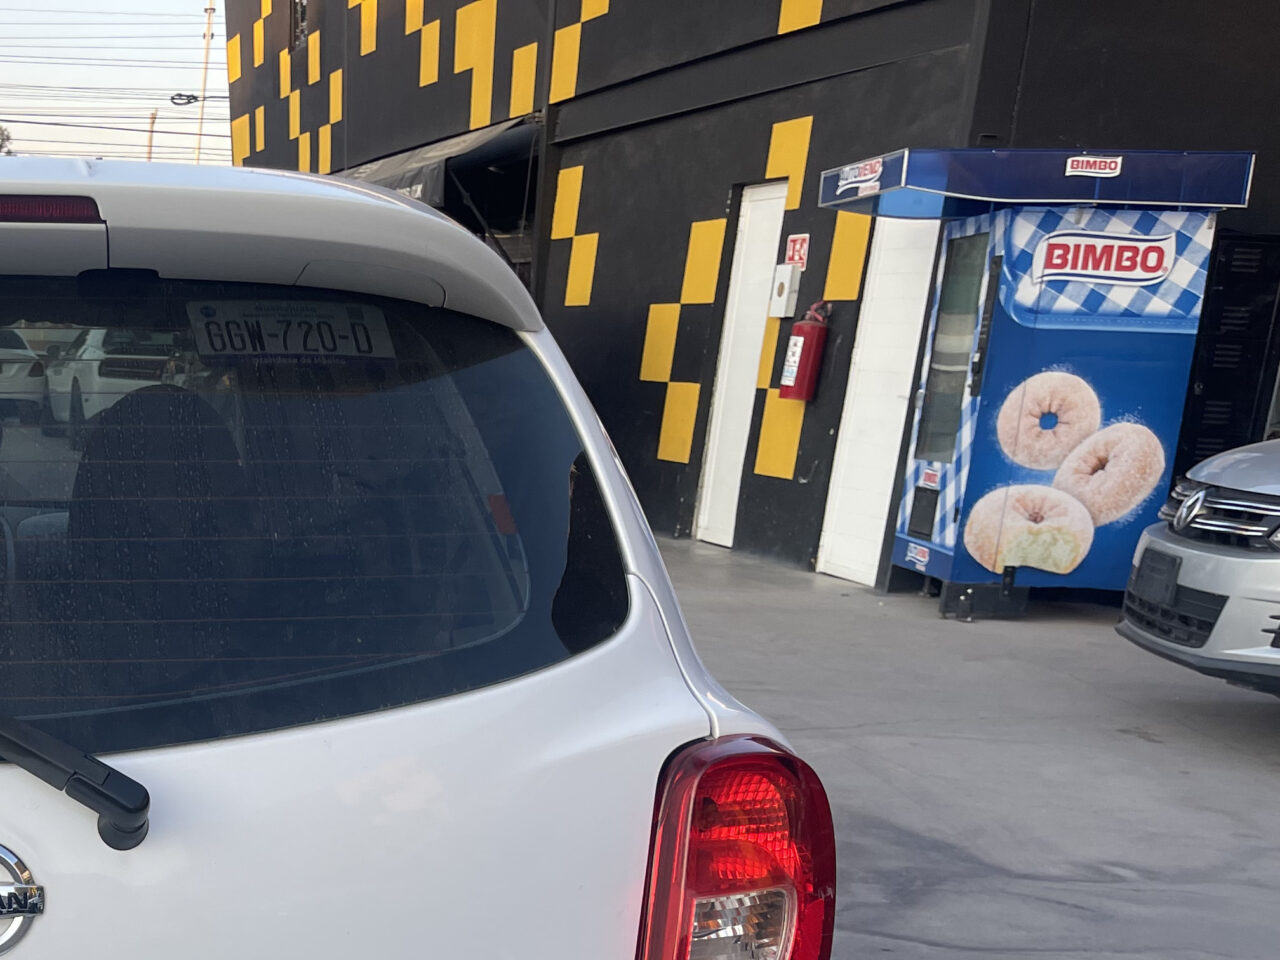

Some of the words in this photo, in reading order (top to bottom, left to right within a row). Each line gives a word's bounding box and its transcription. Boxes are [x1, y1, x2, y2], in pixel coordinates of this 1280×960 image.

[1070, 159, 1118, 171] BIMBO
[1044, 243, 1165, 274] BIMBO
[204, 319, 374, 354] GGW-720-D
